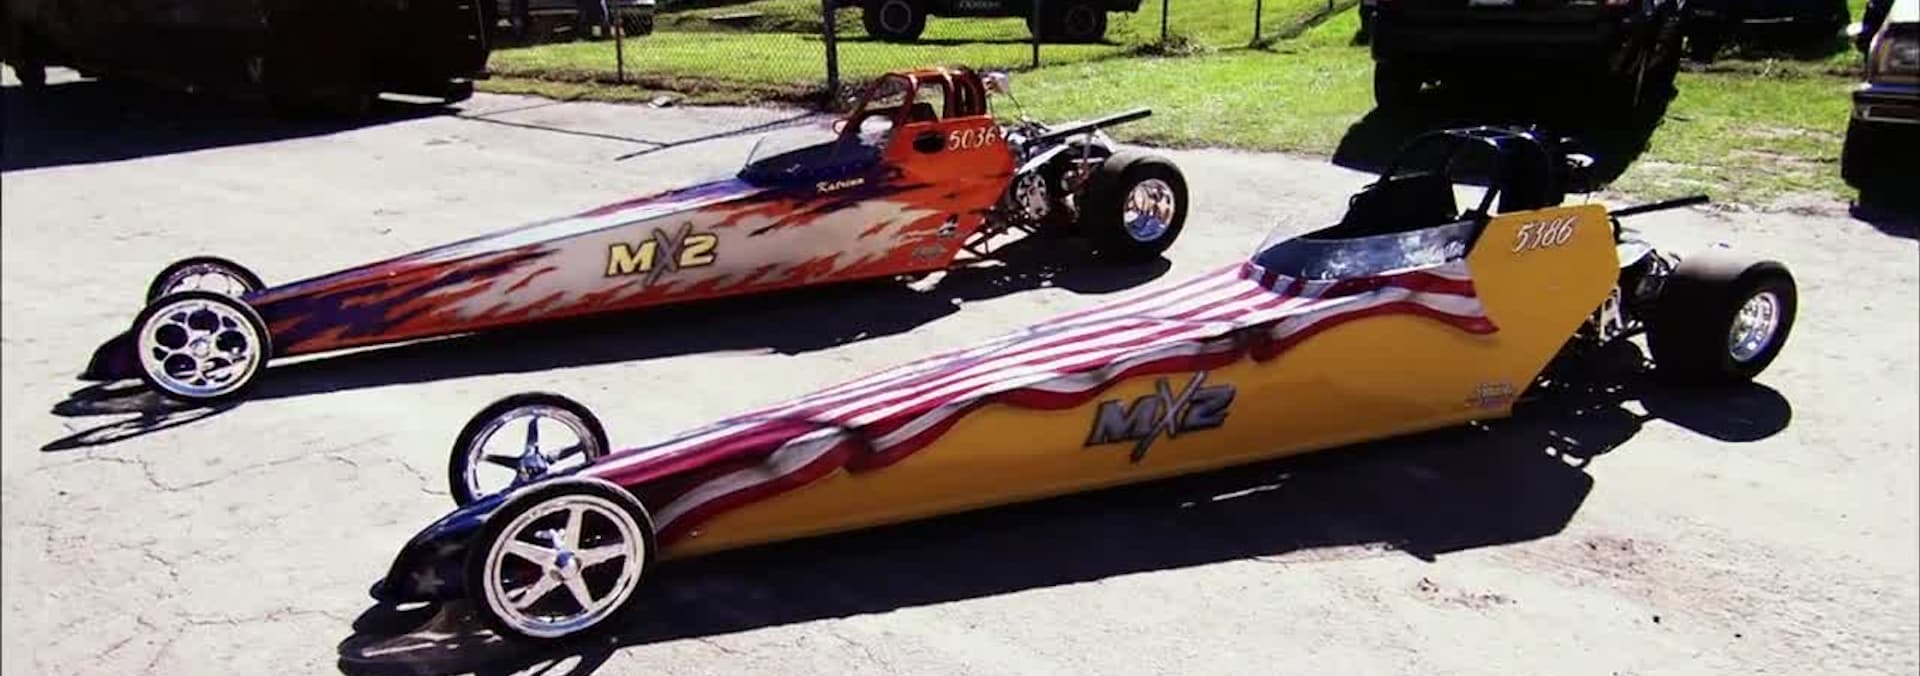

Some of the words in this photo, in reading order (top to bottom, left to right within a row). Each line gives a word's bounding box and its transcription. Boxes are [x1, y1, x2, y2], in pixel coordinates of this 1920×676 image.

[948, 126, 997, 151] 5036
[605, 221, 719, 288] MX2
[1511, 215, 1578, 253] 5386
[1084, 371, 1236, 463] MX2
